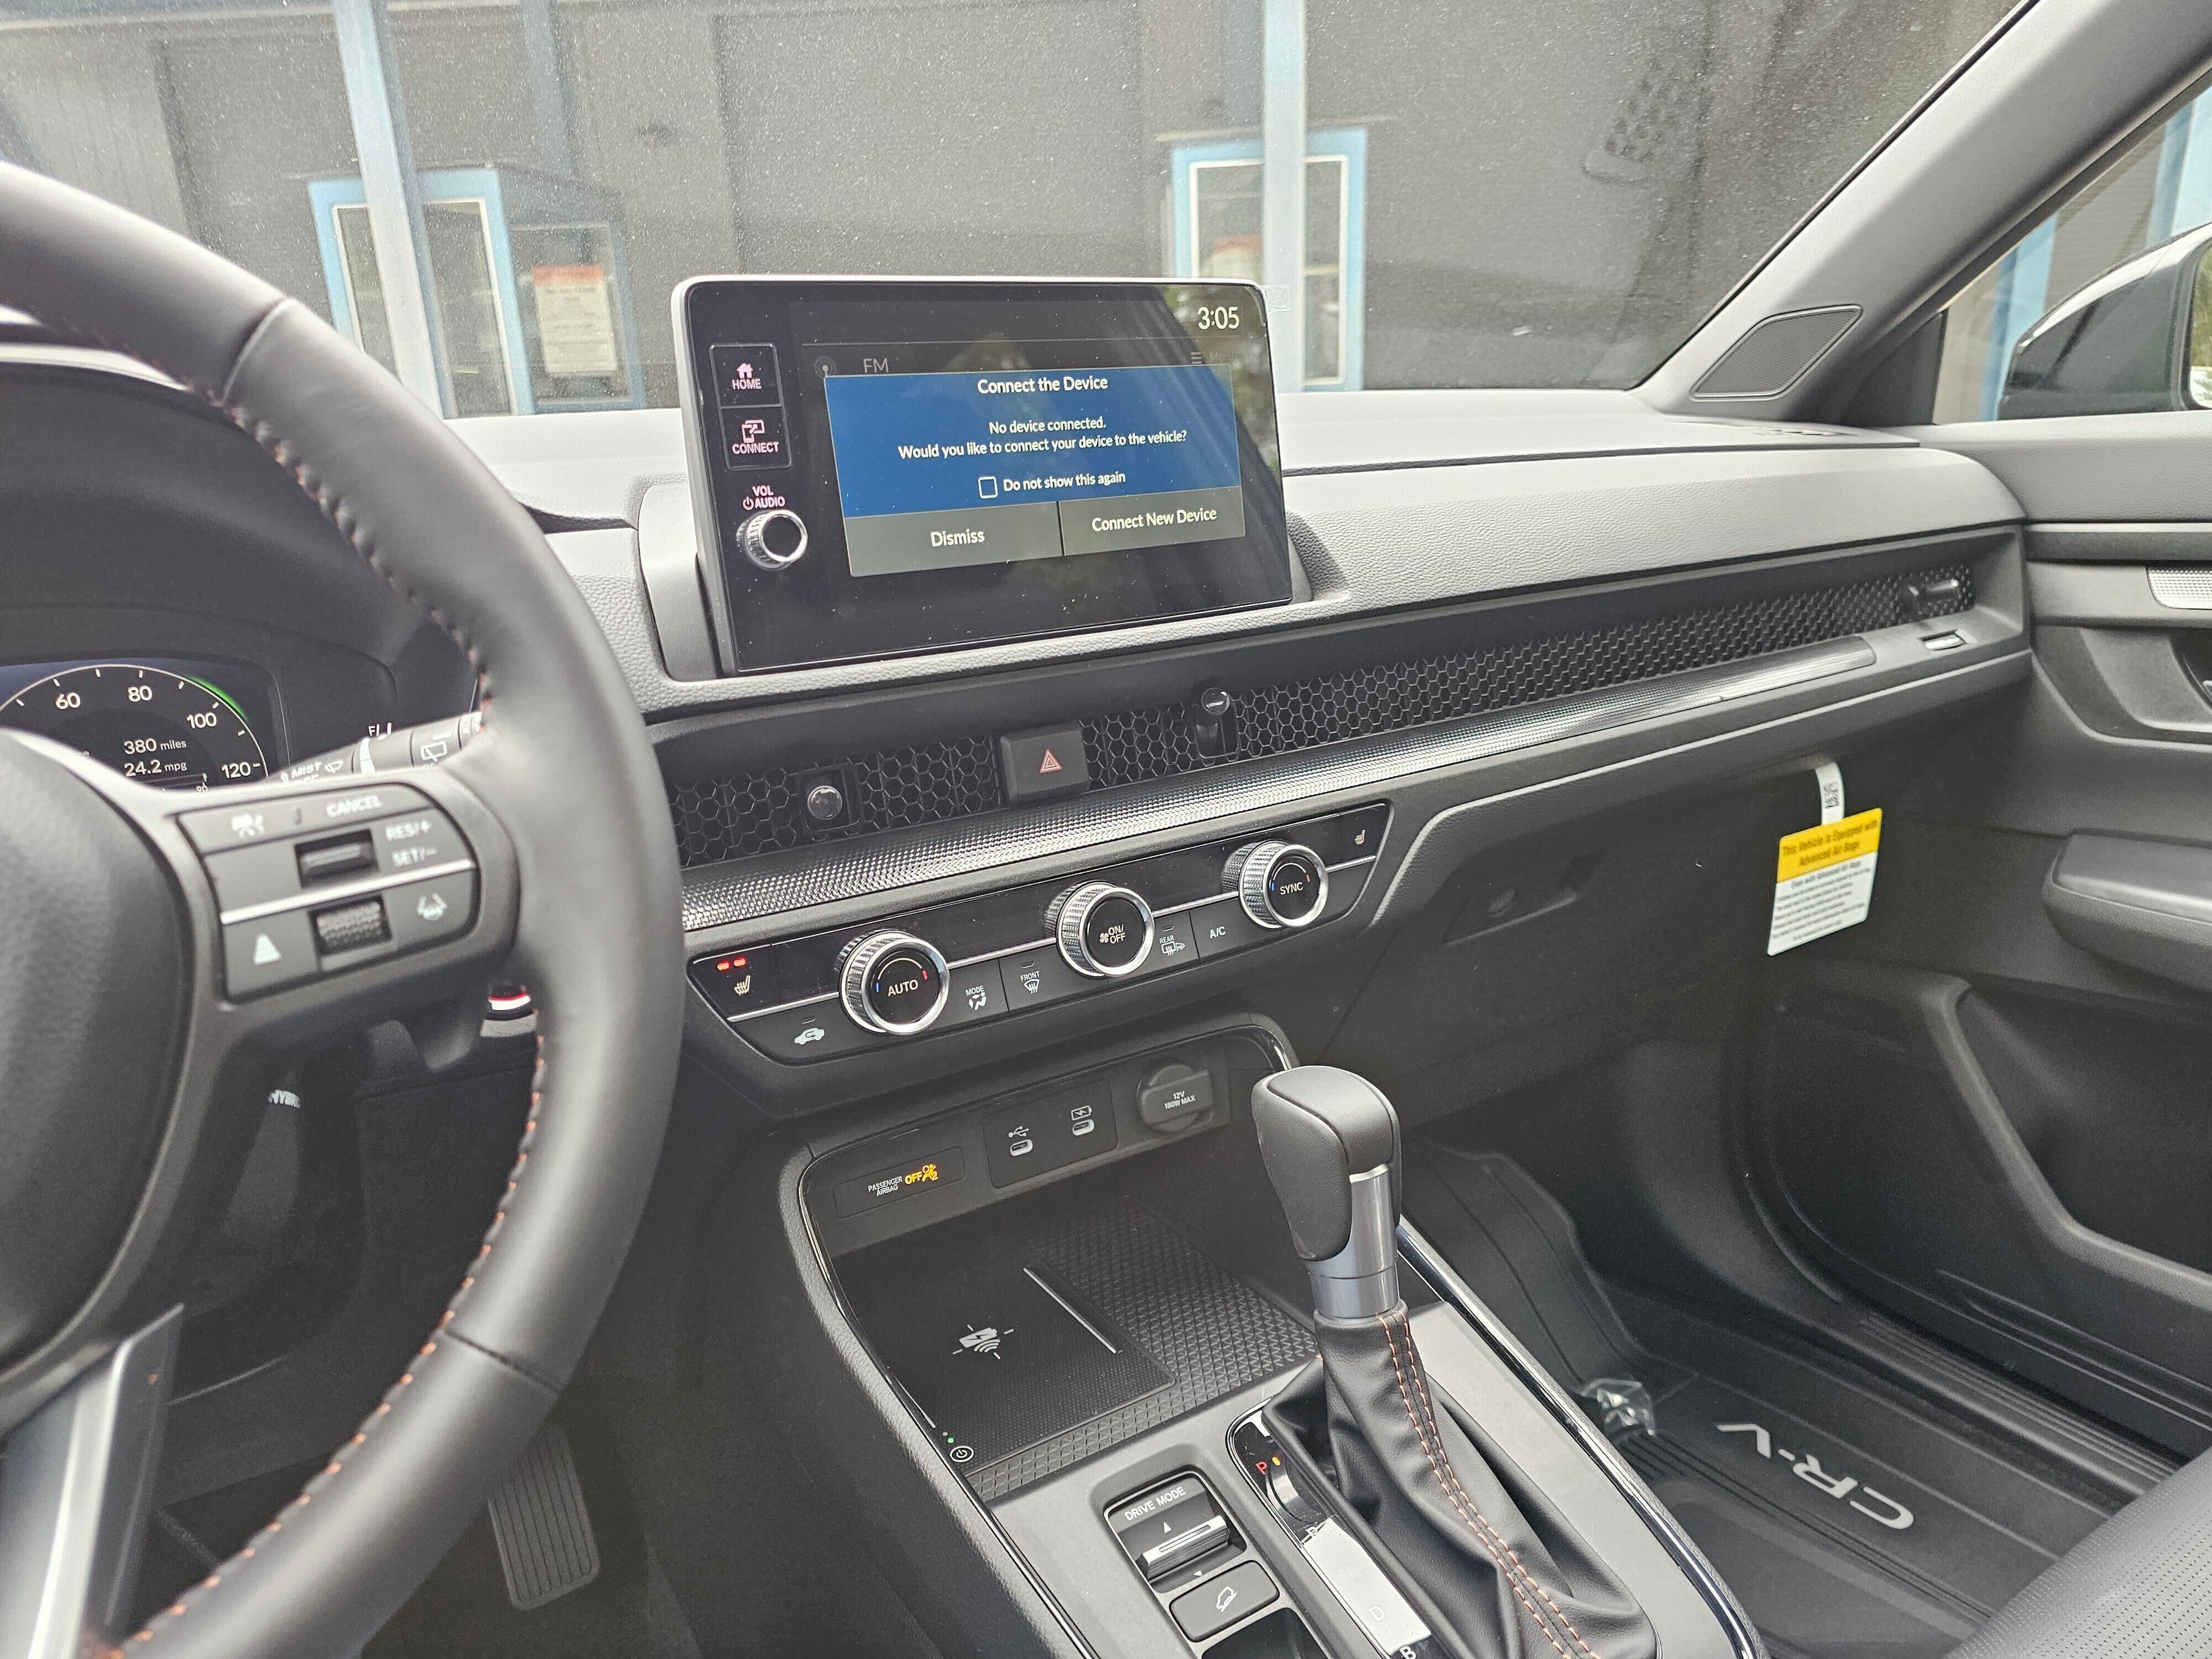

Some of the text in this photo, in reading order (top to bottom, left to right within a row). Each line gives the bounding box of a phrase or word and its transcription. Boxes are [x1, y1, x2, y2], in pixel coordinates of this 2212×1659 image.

[1197, 306, 1240, 330] 3:05
[863, 358, 889, 373] FM
[732, 378, 761, 390] HOME
[977, 375, 1108, 394] Connect the Device
[989, 416, 1107, 434] No device connected.
[732, 441, 779, 455] CONNECT
[898, 430, 1187, 459] Would you like to connect your device to the vehicle?
[1003, 471, 1126, 492] Do not show this again
[752, 485, 774, 497] VOL
[755, 496, 785, 509] AUDIO
[1092, 507, 1217, 532] Connect New Device
[931, 529, 985, 547] Dismiss
[55, 692, 81, 709] 60
[128, 685, 153, 702] 80
[186, 712, 217, 729] 100
[124, 738, 187, 755] 380 miles
[124, 759, 187, 777] 24.2 mpg
[221, 761, 251, 779] 120
[291, 761, 322, 779] MIST
[326, 795, 383, 817] CANCEL
[1280, 882, 1303, 895] SYNC
[1108, 924, 1124, 936] ON/
[1109, 932, 1126, 945] OFF
[1210, 926, 1225, 939] A/C
[1160, 935, 1174, 945] REAR
[1020, 971, 1040, 982] FRONT
[888, 979, 919, 997] AUTO
[966, 985, 984, 996] MODE
[1164, 1094, 1196, 1109] 180W MAX
[1173, 1091, 1185, 1100] 12V
[868, 1176, 903, 1193] PASSENGER
[905, 1171, 923, 1185] OFF
[876, 1184, 899, 1197] AIRBAG
[1255, 1461, 1267, 1475] P
[1716, 1423, 1914, 1530] CR-V
[1124, 1486, 1186, 1521] DRIVE MODE
[1368, 1605, 1385, 1621] D
[1399, 1645, 1417, 1659] B
